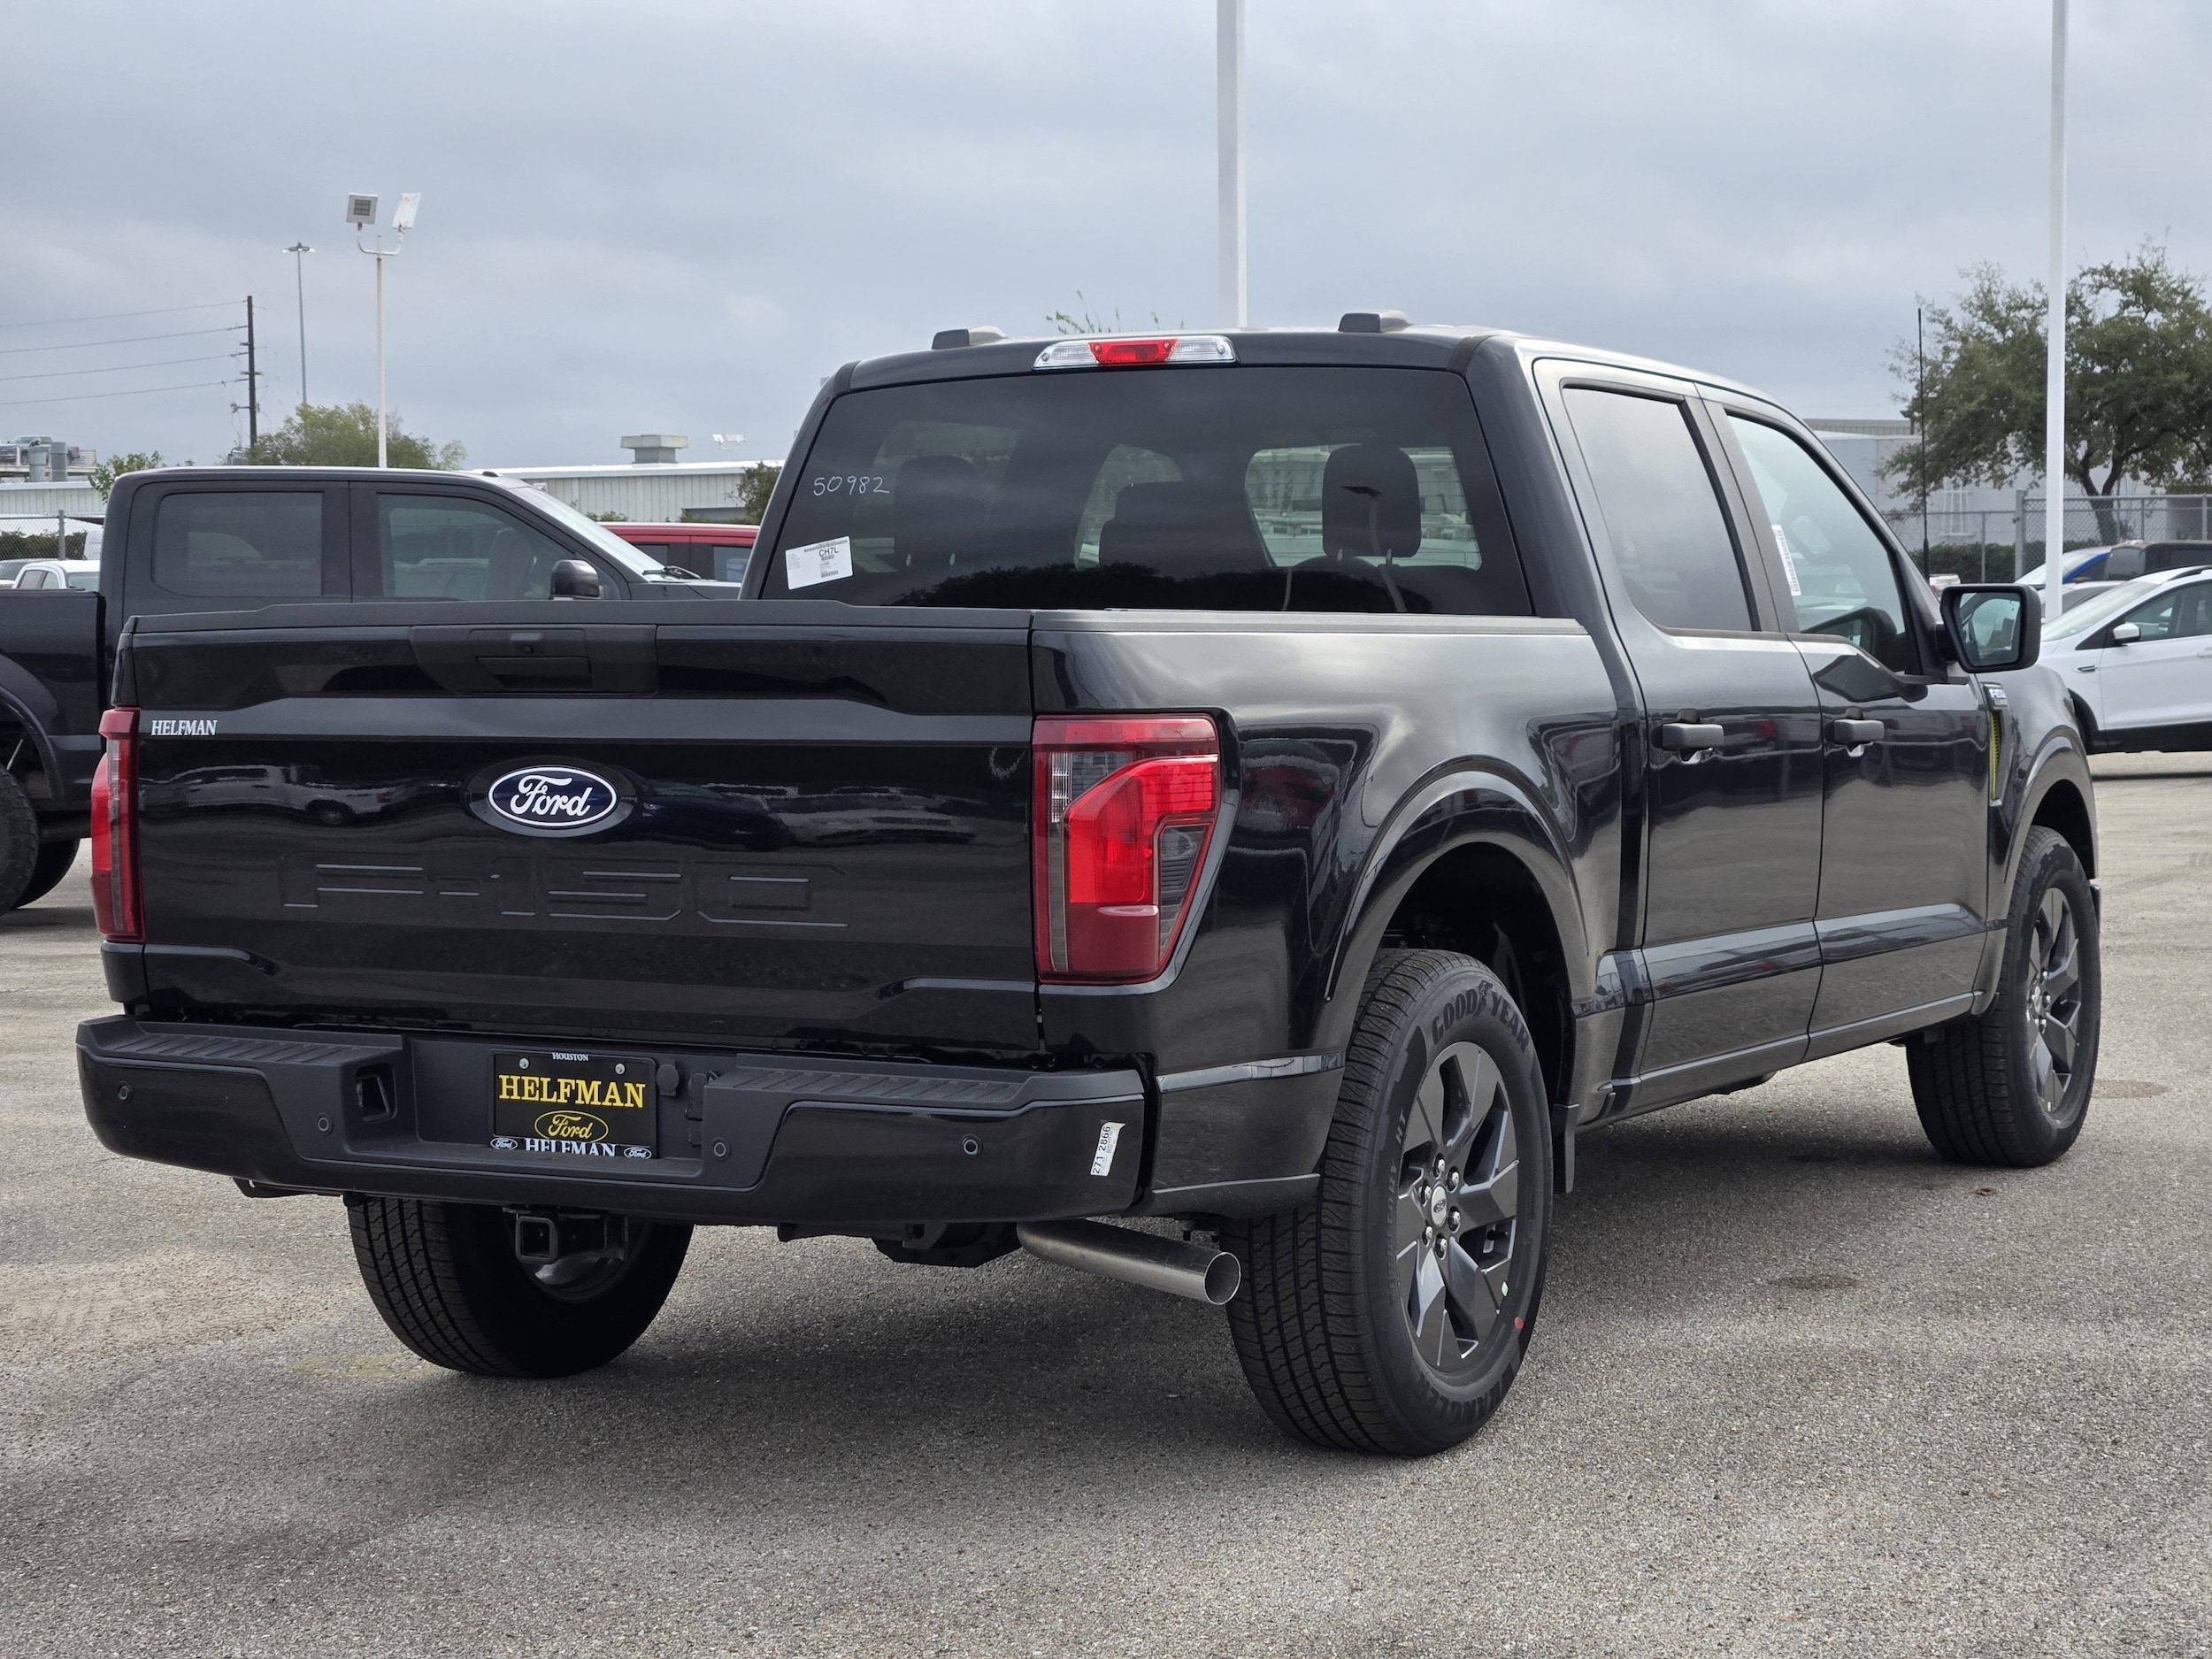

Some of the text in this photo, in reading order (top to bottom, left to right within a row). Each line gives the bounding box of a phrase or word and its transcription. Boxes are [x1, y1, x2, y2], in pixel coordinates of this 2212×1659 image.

[813, 476, 890, 495] 50982
[818, 547, 840, 557] CH7L
[150, 720, 218, 736] HELFMAN
[510, 775, 594, 817] Ford
[1432, 987, 1530, 1054] GOODYEAR
[551, 1052, 589, 1062] HOUSTON
[498, 1074, 646, 1109] HELFMAN
[548, 1114, 593, 1140] Ford
[1092, 1156, 1104, 1174] 271
[1098, 1126, 1111, 1151] 2866
